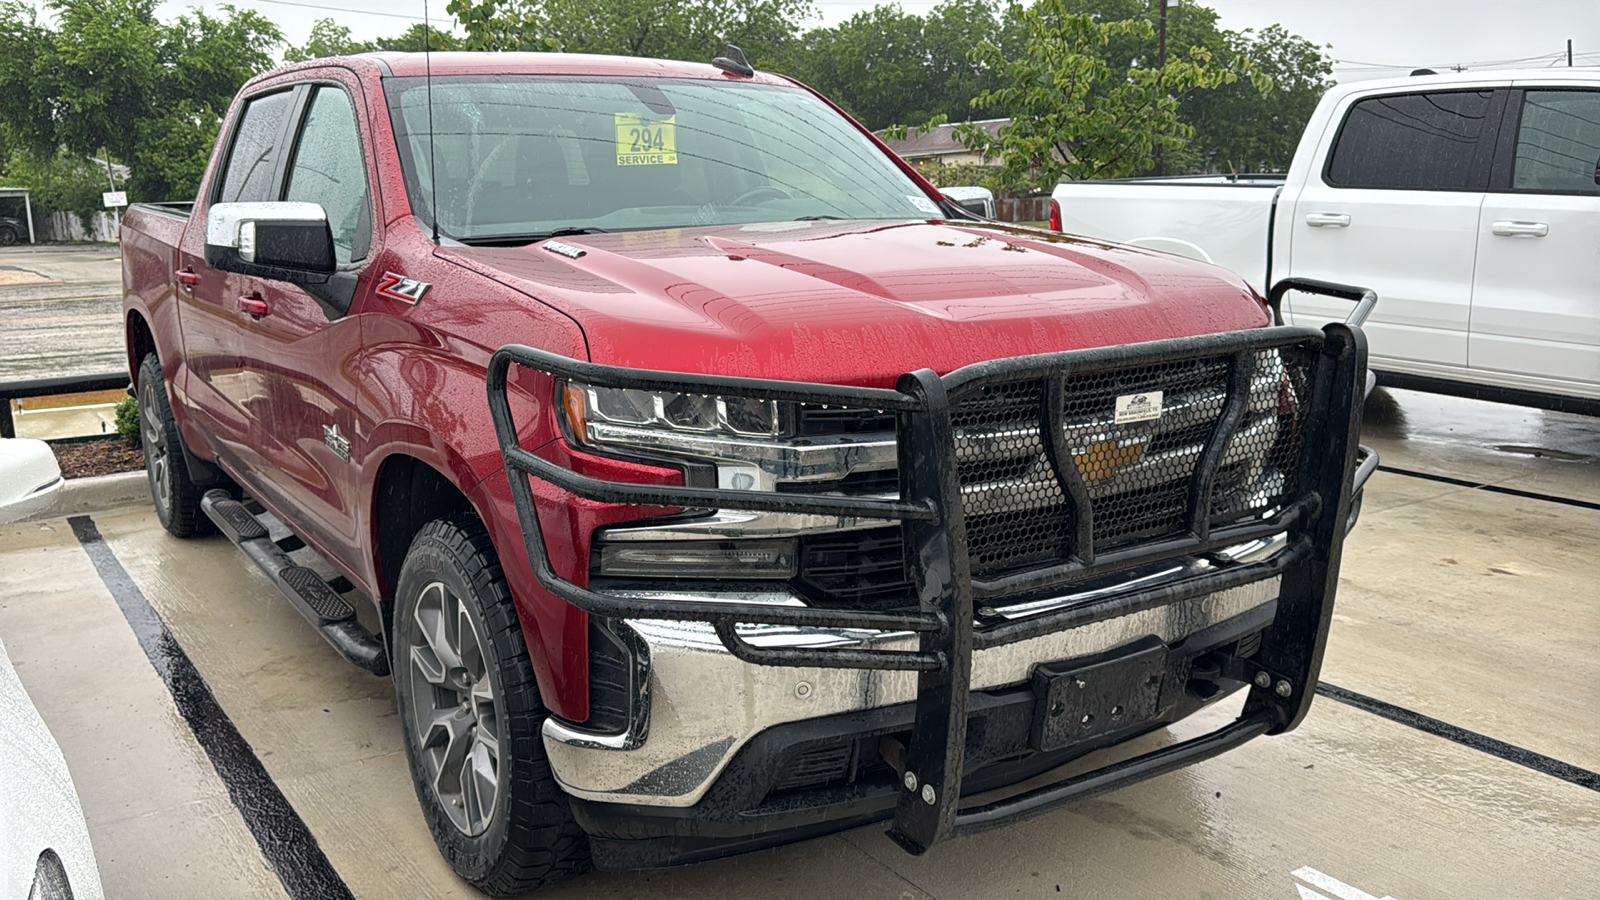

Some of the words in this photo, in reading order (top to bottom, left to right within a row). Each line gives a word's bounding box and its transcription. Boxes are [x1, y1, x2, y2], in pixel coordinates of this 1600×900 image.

[630, 127, 664, 152] 294
[618, 155, 663, 165] SERVICE
[375, 271, 431, 306] Z71
